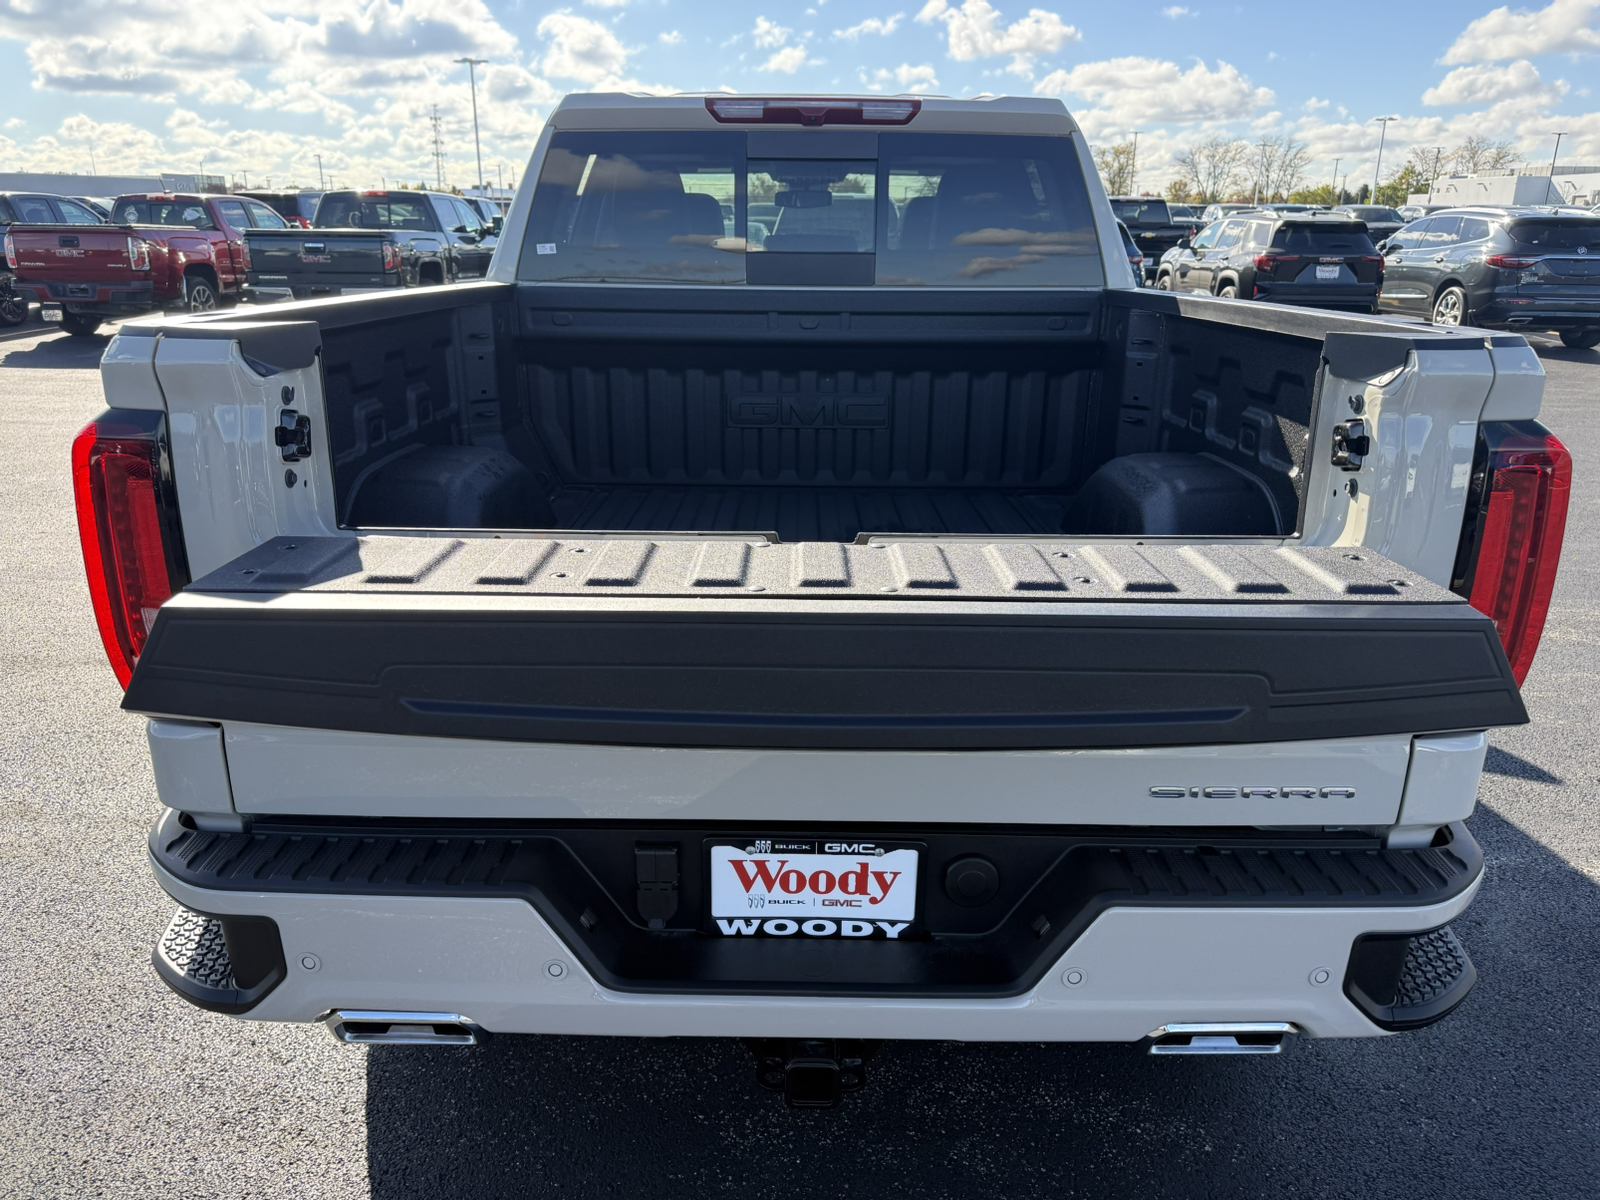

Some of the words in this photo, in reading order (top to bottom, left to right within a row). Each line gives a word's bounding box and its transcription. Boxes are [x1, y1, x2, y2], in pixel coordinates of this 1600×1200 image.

[302, 255, 331, 263] GMC
[730, 397, 886, 426] GMC
[1149, 786, 1356, 799] SIERRA
[824, 843, 875, 853] GMC
[727, 859, 902, 905] Woody
[821, 899, 862, 908] GMC
[716, 919, 910, 938] WOODY
